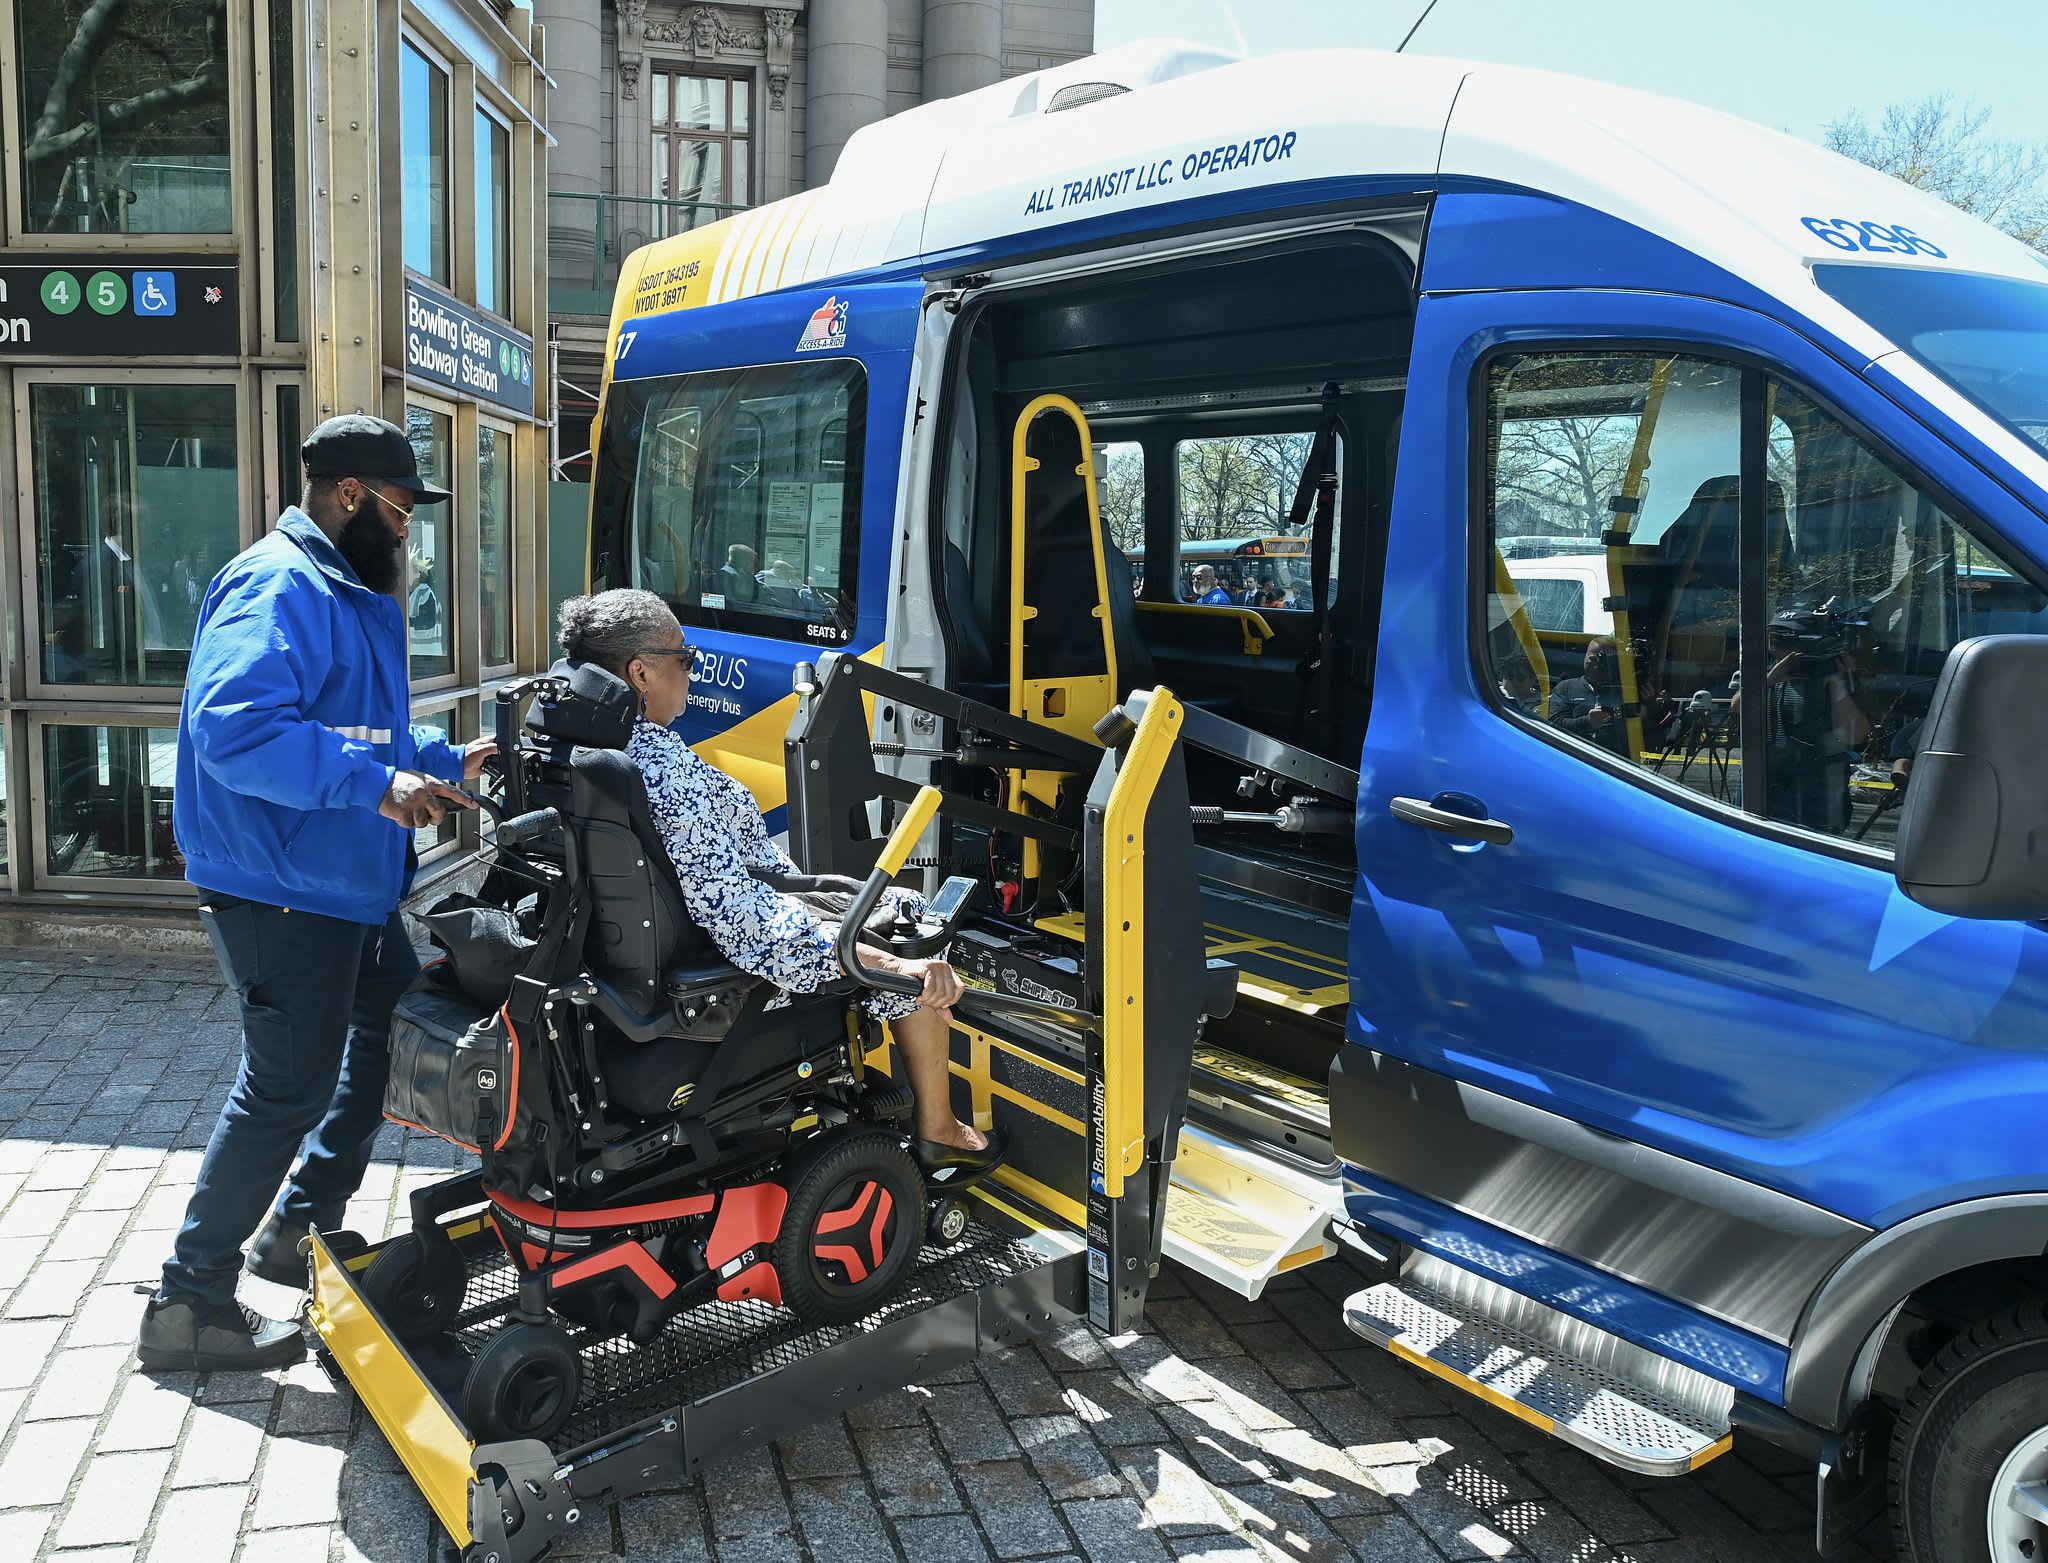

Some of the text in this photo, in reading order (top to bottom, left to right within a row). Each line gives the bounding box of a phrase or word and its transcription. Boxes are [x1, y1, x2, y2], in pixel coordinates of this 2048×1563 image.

[1024, 131, 1297, 215] ALL TRANSIT LLC. OPERATOR
[1800, 216, 1948, 259] 6296
[638, 260, 701, 293] USDOT 3643195
[50, 280, 116, 306] 4 5
[635, 285, 688, 314] NYDOT 36977
[408, 295, 458, 351] Bowling
[461, 320, 492, 359] Green
[798, 337, 845, 350] ACCESS-A-RIDE
[409, 332, 498, 394] Subway Station
[807, 624, 848, 641] SEATS 4
[687, 692, 742, 716] energy bus
[480, 1075, 494, 1087] Ag
[1092, 1077, 1106, 1174] BraunAbility
[741, 1249, 755, 1265] F3
